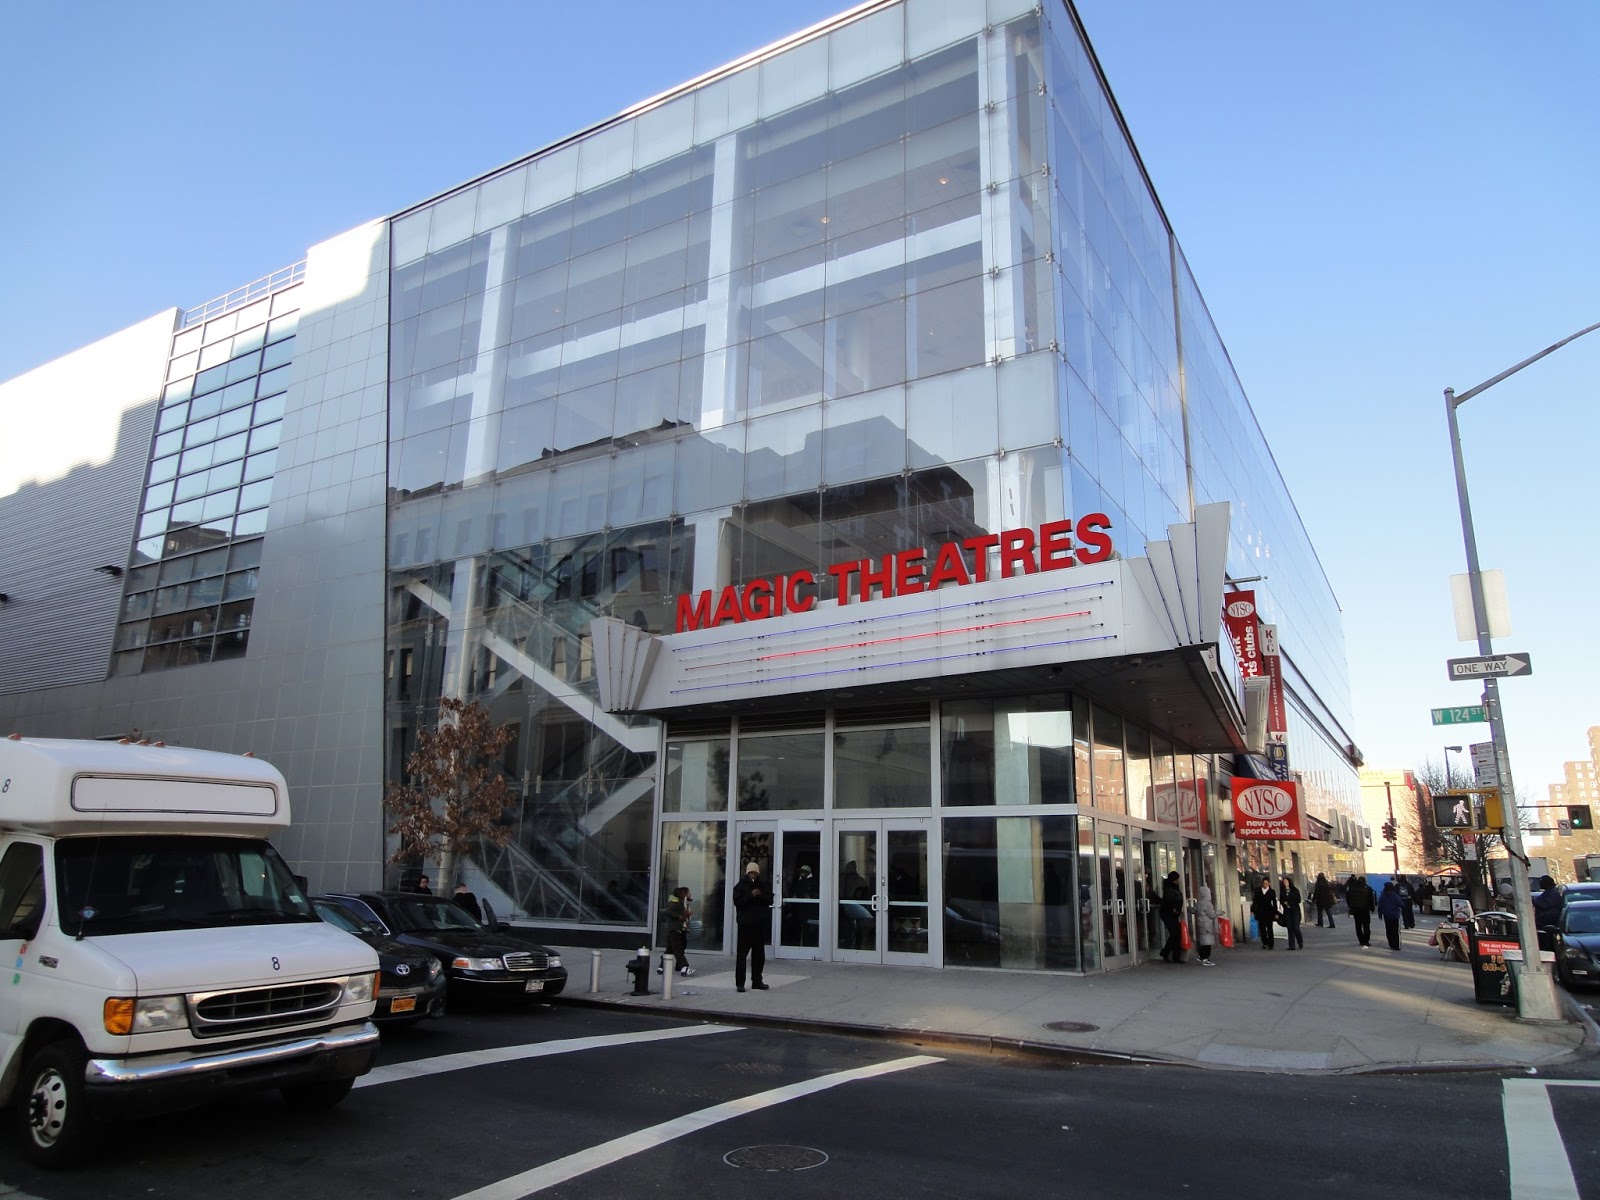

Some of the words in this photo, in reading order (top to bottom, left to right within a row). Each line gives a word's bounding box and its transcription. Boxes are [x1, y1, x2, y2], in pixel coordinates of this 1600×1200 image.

[675, 571, 818, 633] MAGIC
[829, 512, 1117, 606] THEATRES
[1230, 603, 1252, 616] NYSC
[1244, 625, 1256, 659] clubs
[1456, 663, 1479, 674] ONE
[1484, 661, 1507, 671] WAY
[1433, 710, 1443, 724] W
[1449, 709, 1470, 722] 124
[2, 778, 11, 793] 8
[1244, 789, 1285, 815] NYSC
[1267, 819, 1288, 828] york
[1240, 827, 1269, 836] sports
[1271, 827, 1296, 836] clubs
[271, 956, 280, 971] 8
